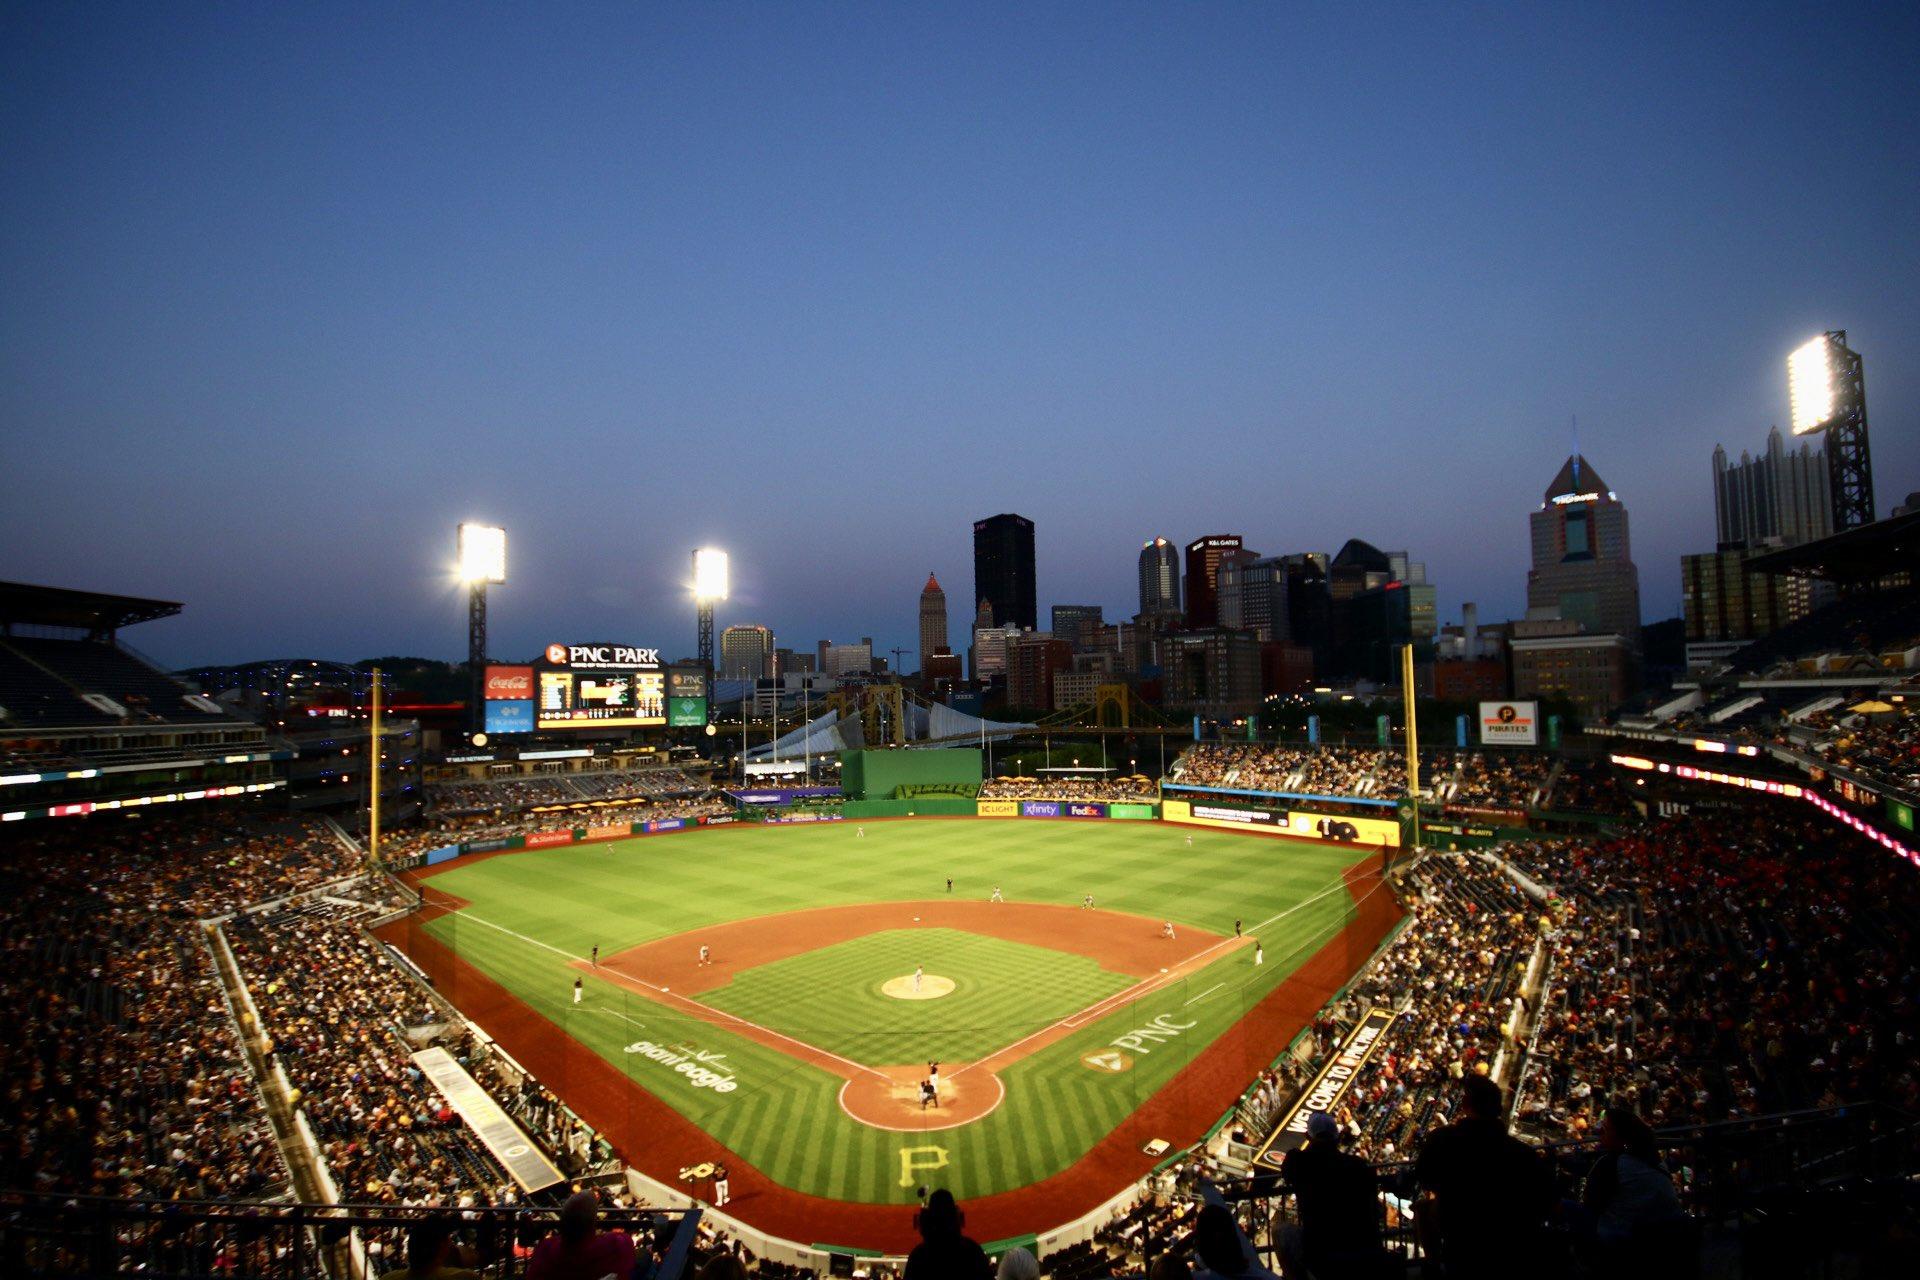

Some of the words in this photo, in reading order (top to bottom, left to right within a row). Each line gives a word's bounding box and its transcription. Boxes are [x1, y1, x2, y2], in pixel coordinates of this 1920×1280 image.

[569, 646, 610, 662] PNC
[614, 647, 659, 663] PARK
[682, 675, 704, 685] PNC
[1488, 725, 1528, 733] PIRATES
[991, 805, 1014, 813] LIGHT
[1026, 804, 1057, 816] xfinity
[1071, 806, 1098, 816] FedEx
[706, 816, 734, 824] Fanatics
[1109, 1013, 1198, 1054] PNC
[623, 1041, 690, 1067] giant
[674, 1062, 738, 1093] eagle
[1328, 1065, 1353, 1080] TO
[899, 1145, 949, 1187] P
